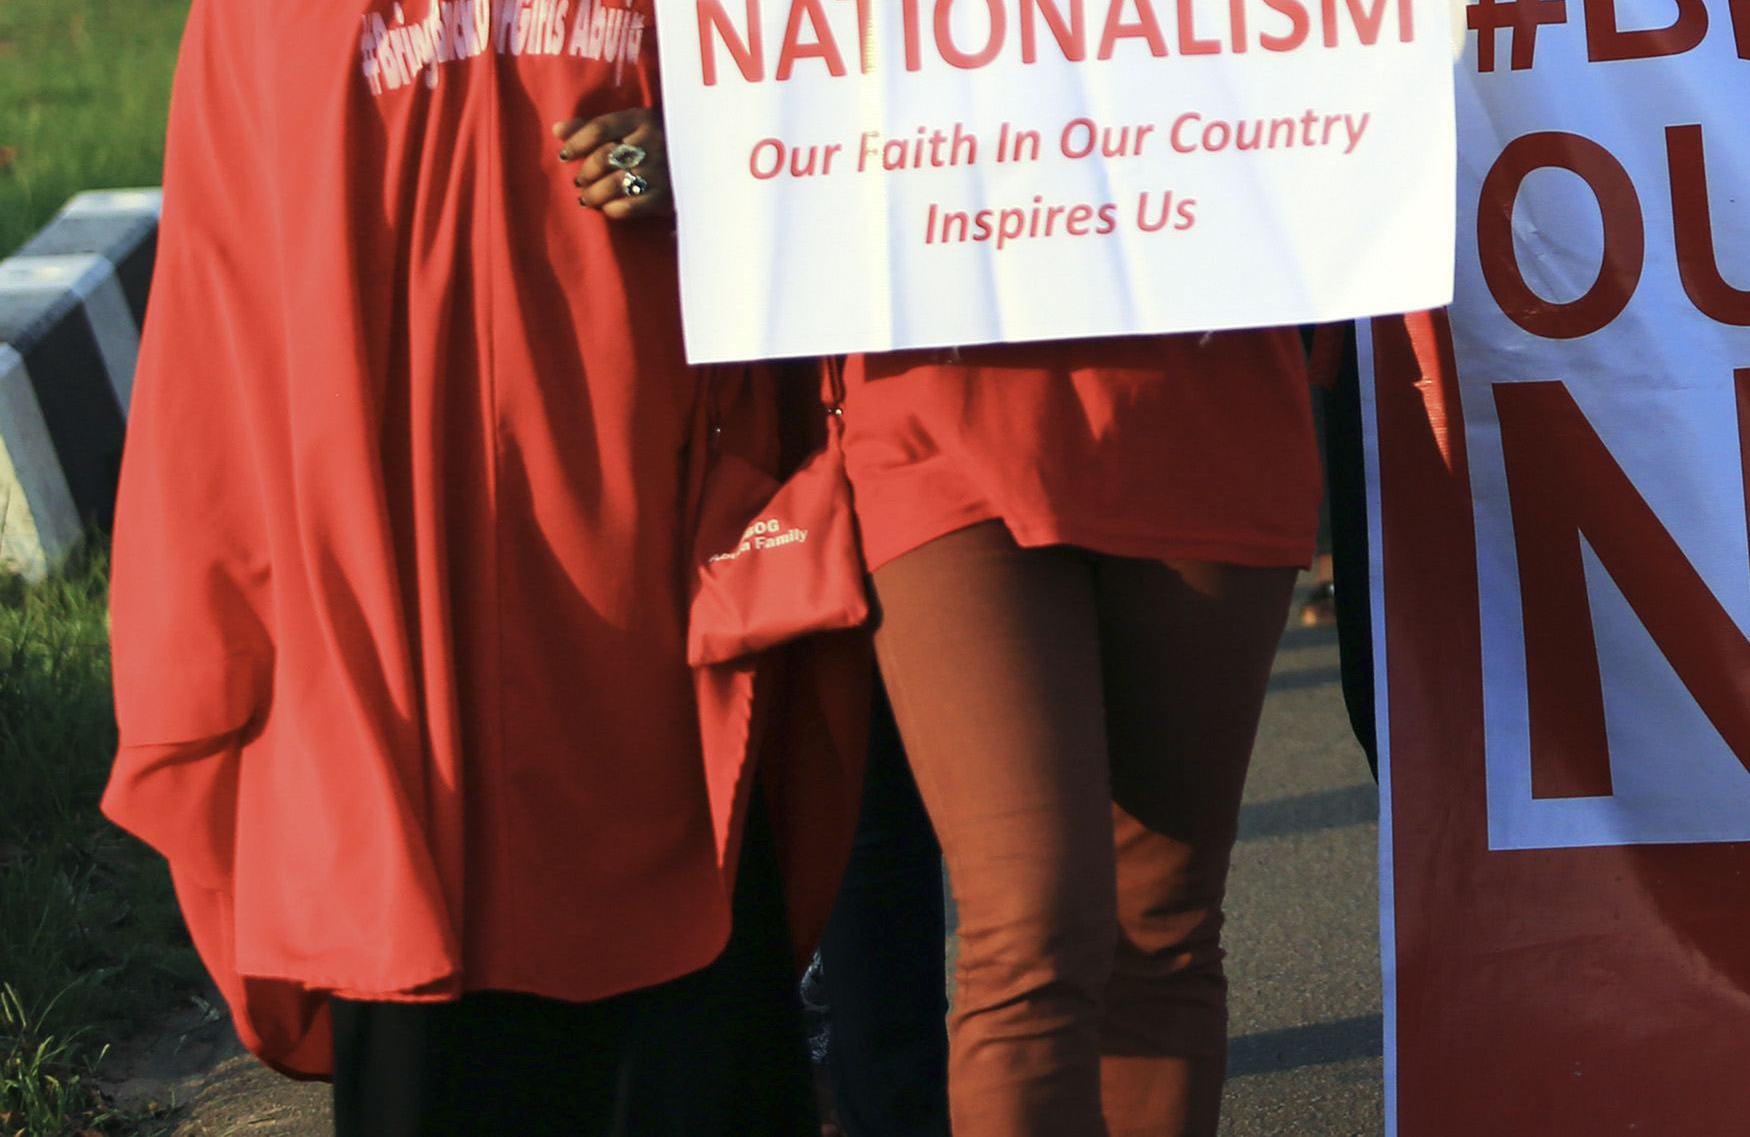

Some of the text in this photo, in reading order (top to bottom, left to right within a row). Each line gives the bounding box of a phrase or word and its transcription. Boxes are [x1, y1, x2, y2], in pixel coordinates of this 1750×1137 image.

[748, 106, 1372, 181] Our Faith In Our Country
[924, 190, 1198, 251] Inspires Us
[755, 528, 808, 550] Family
